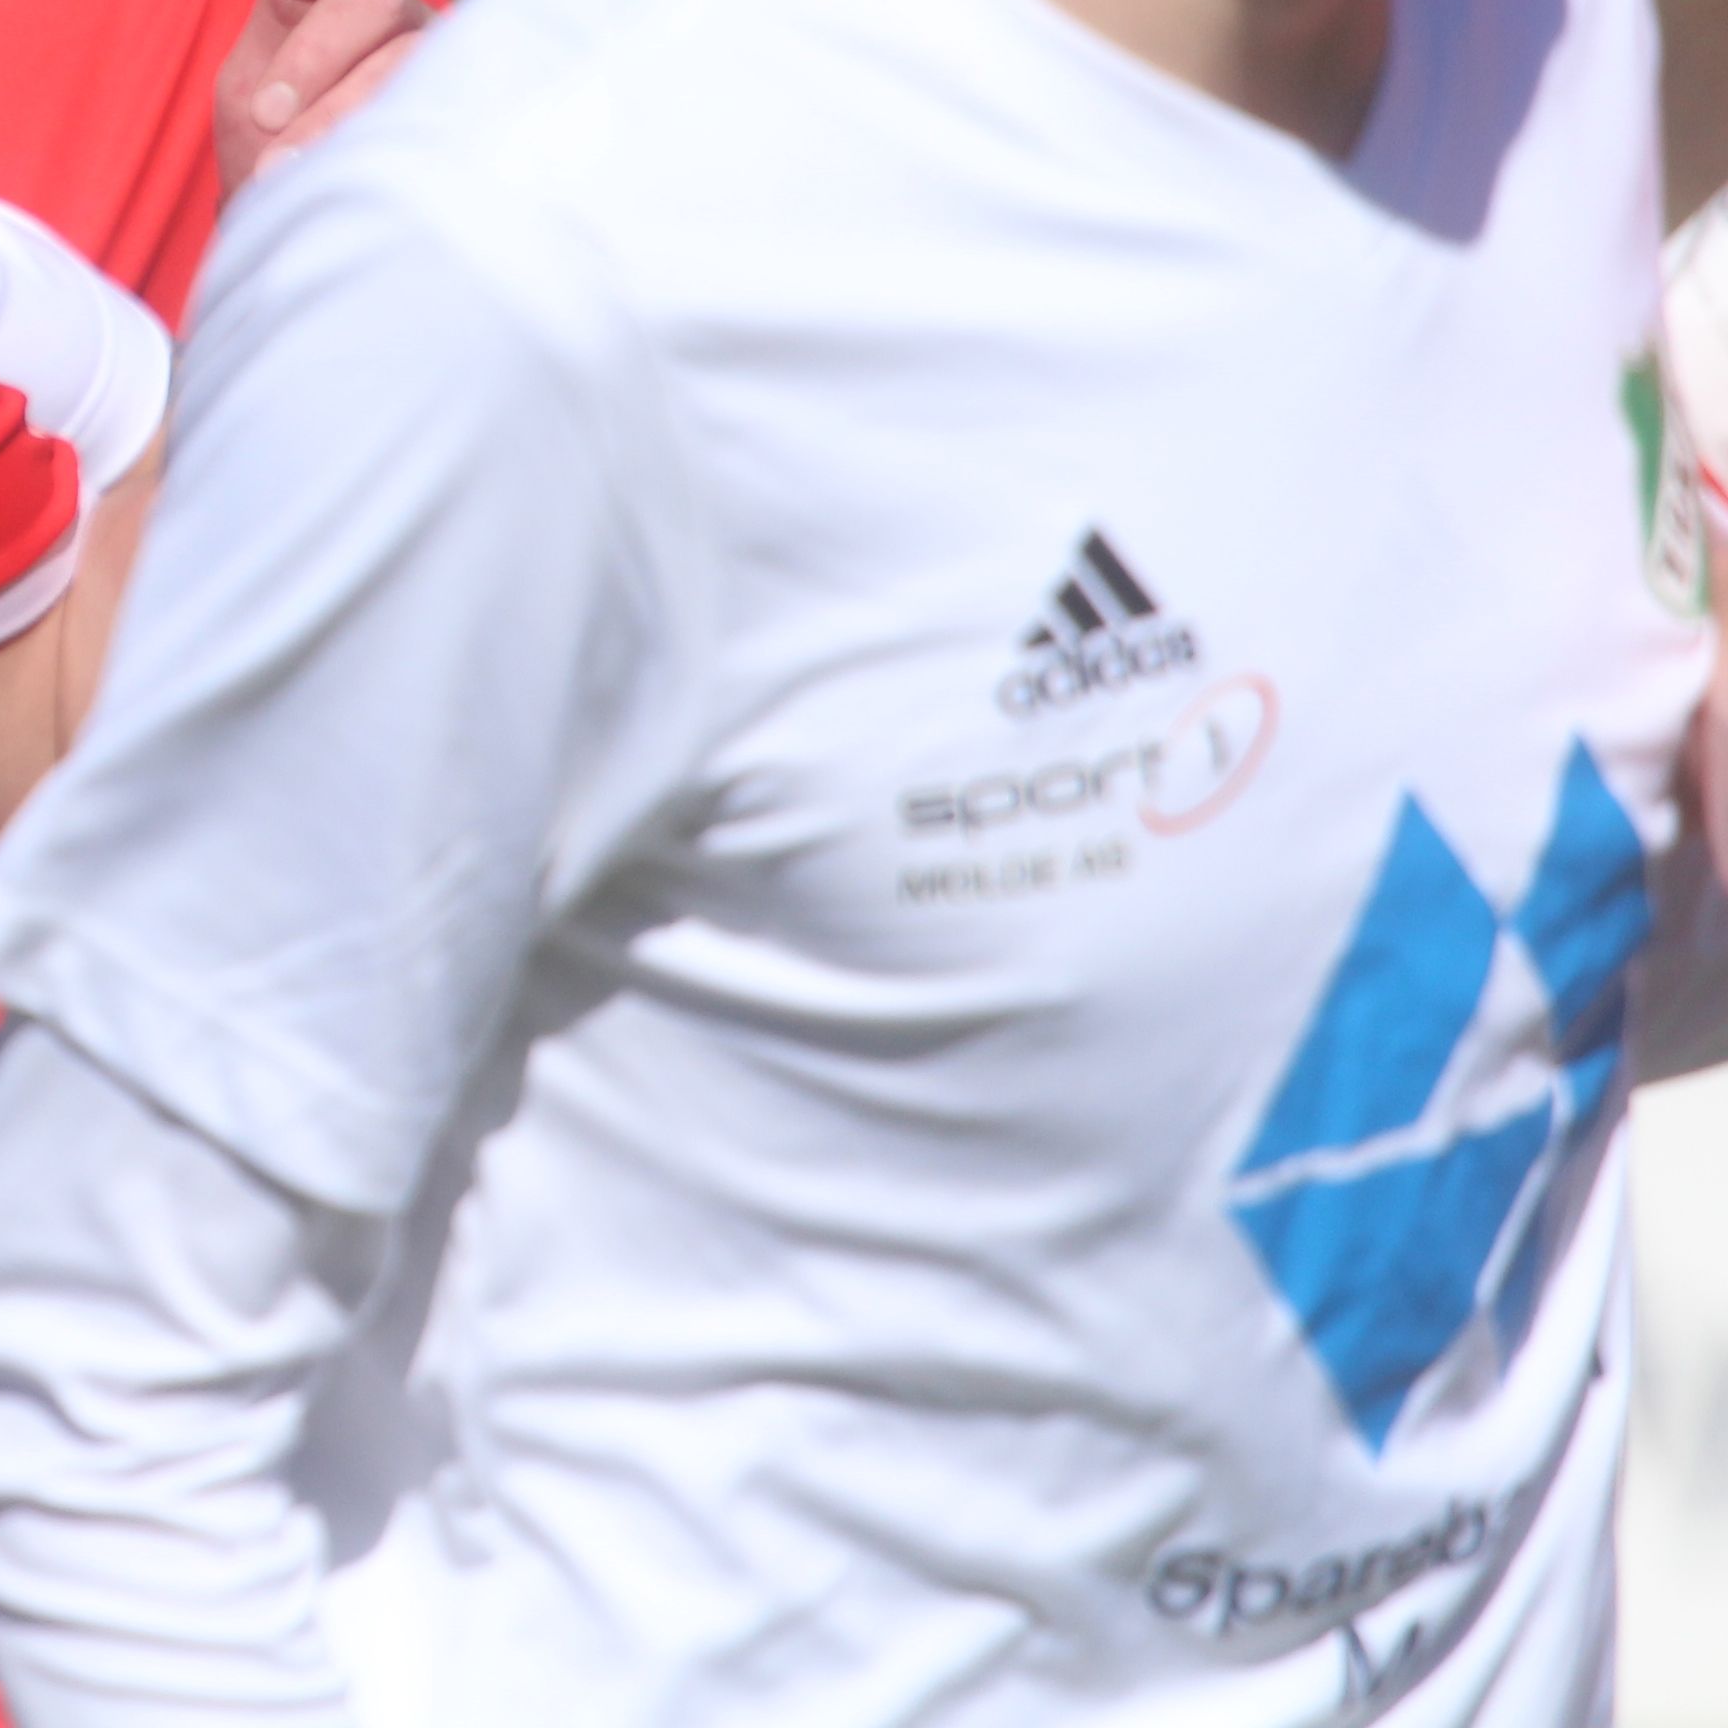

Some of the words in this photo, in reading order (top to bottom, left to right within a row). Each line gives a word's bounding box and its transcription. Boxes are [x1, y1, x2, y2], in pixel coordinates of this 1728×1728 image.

[996, 626, 1198, 718] adidas
[899, 739, 1164, 840] sport
[1149, 1494, 1490, 1638] Spareb
